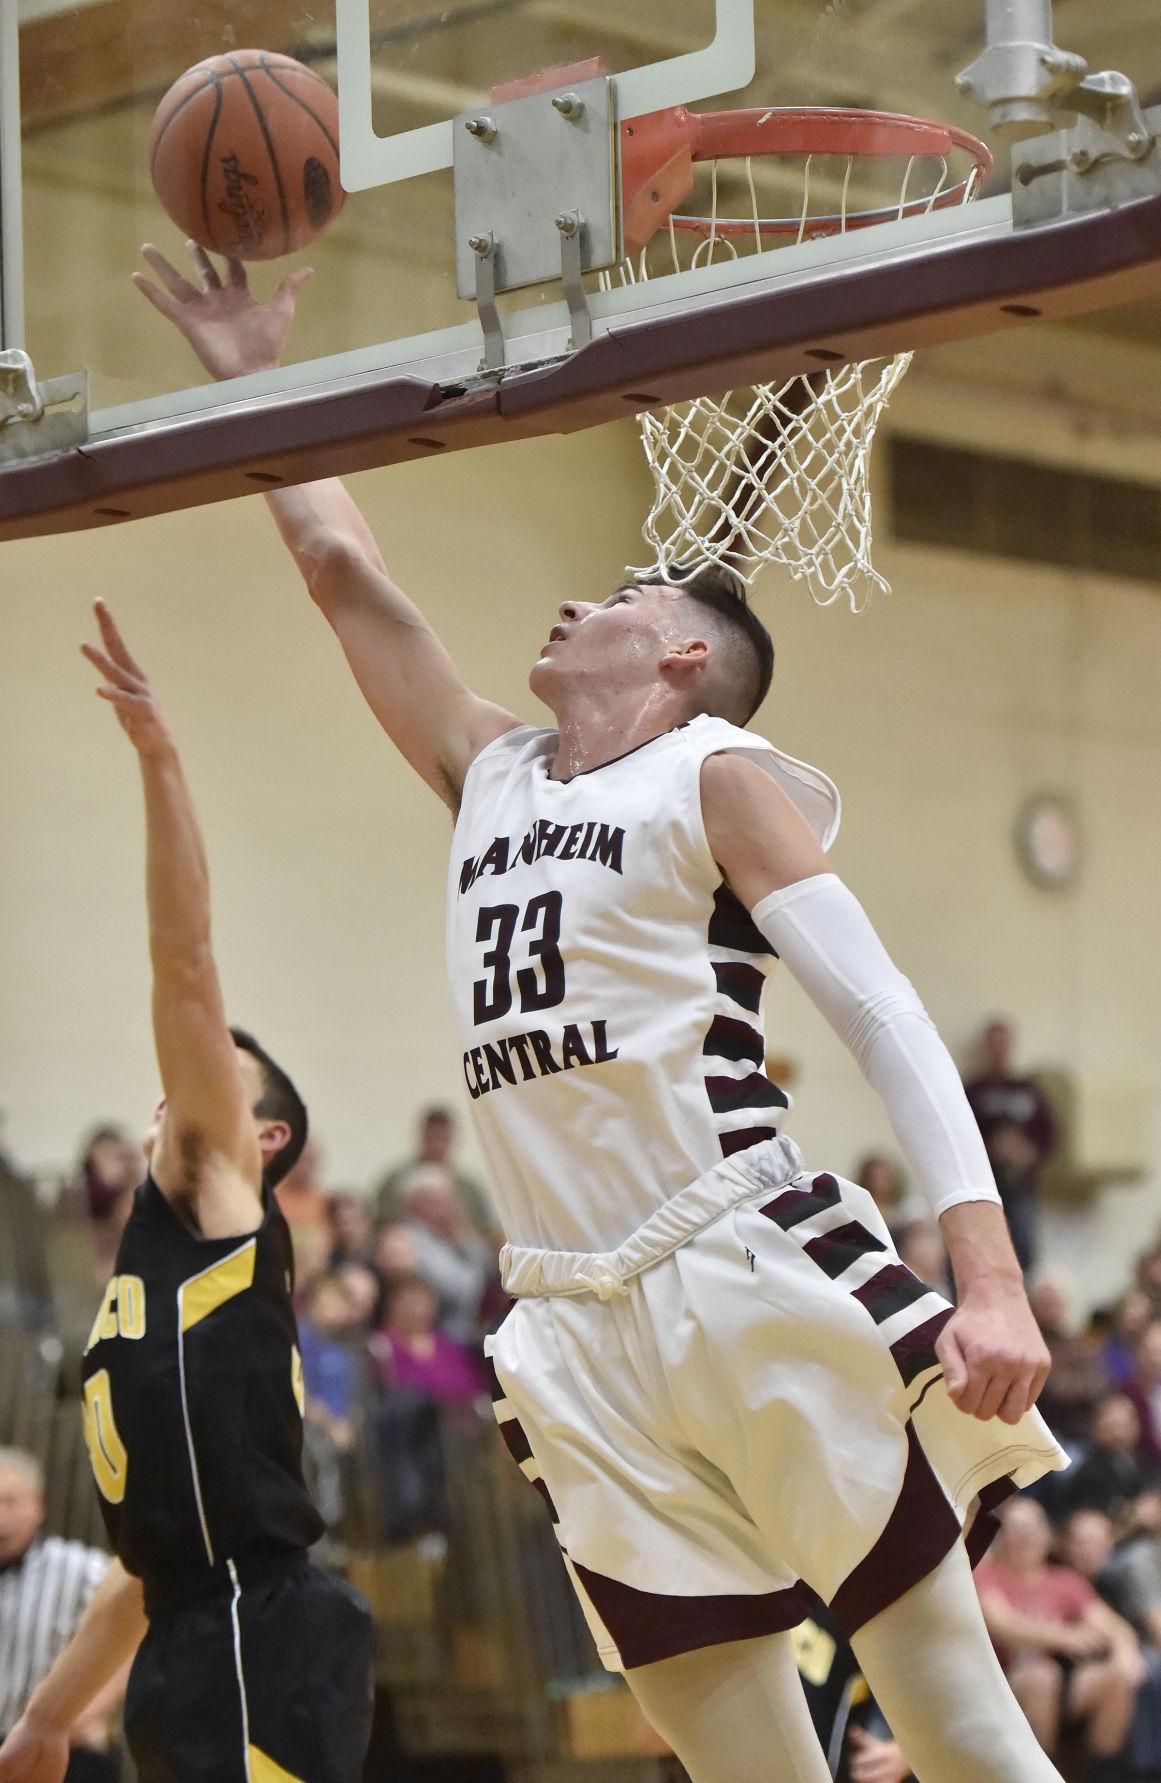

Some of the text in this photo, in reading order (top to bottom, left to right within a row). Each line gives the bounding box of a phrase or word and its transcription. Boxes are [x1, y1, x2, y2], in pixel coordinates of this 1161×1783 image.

[473, 890, 566, 1026] 33
[463, 1019, 620, 1099] CENTRAL
[82, 1368, 128, 1505] 0
